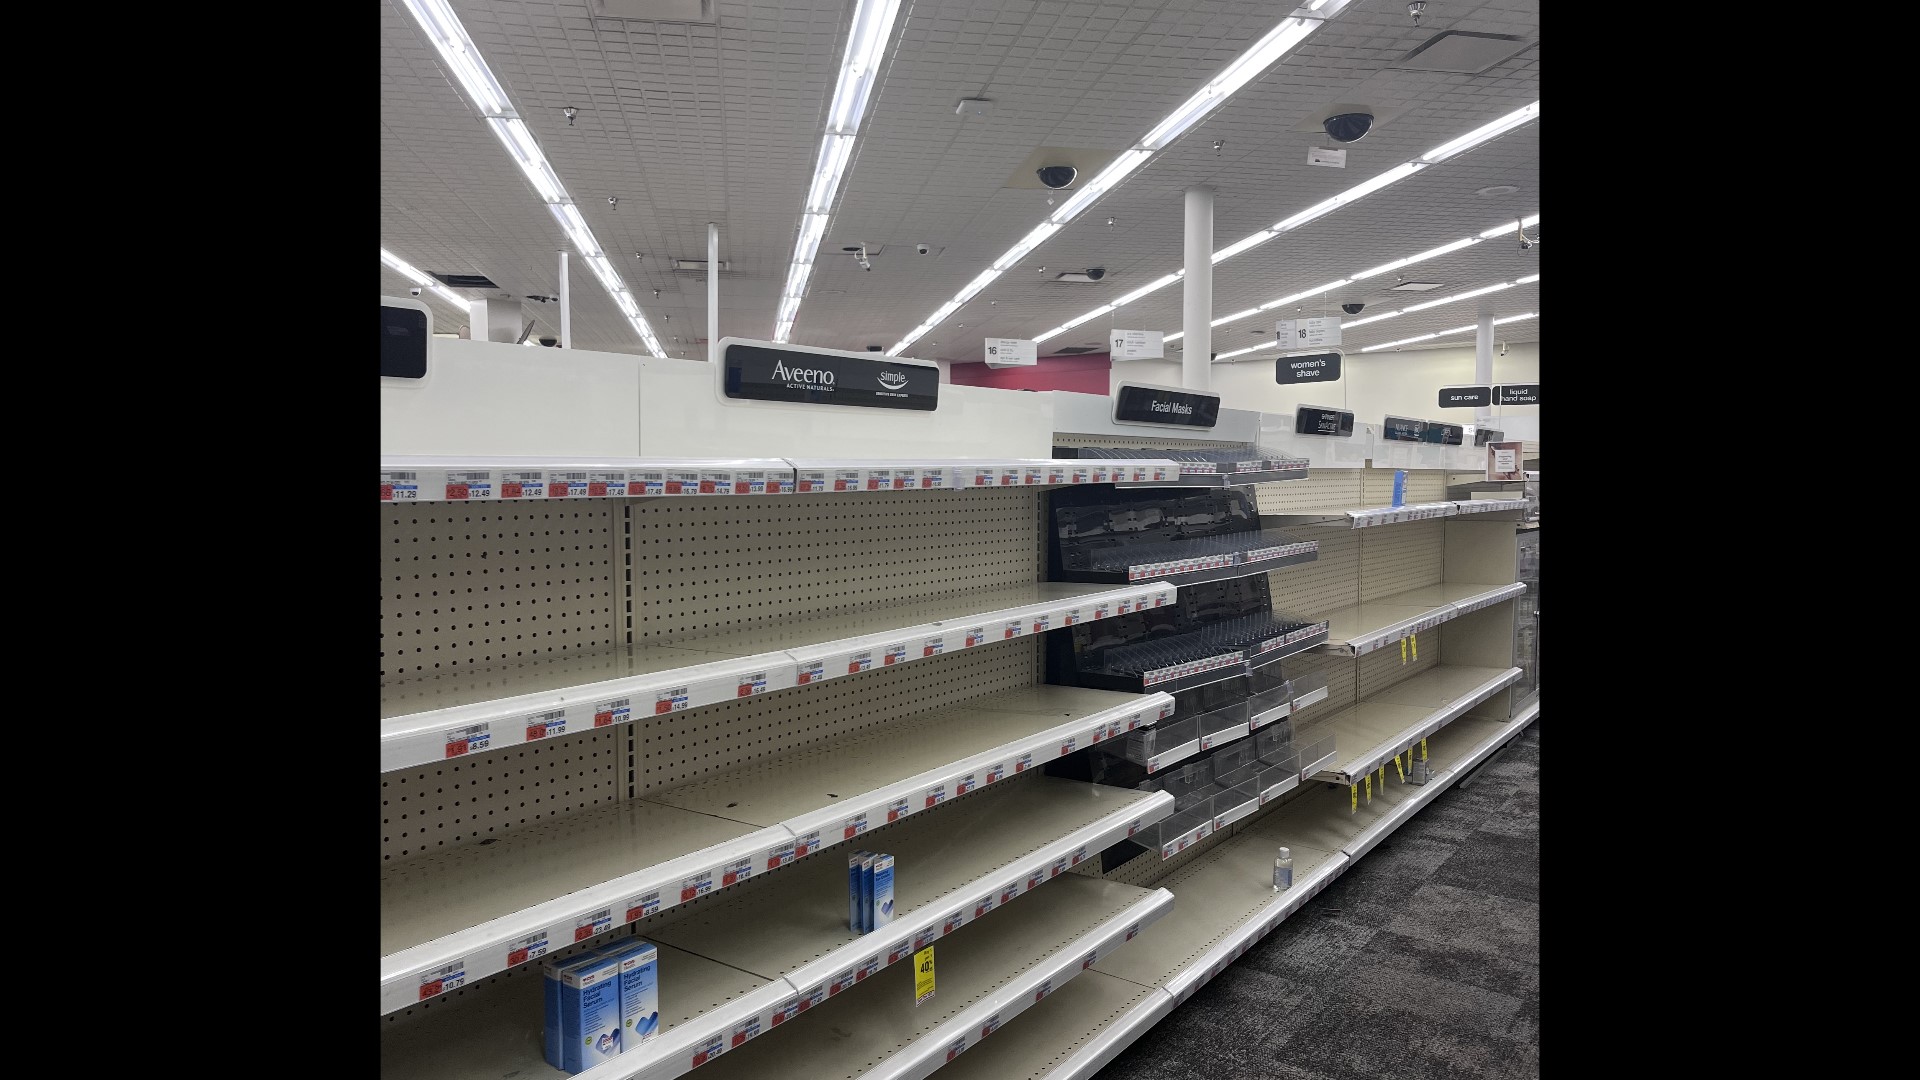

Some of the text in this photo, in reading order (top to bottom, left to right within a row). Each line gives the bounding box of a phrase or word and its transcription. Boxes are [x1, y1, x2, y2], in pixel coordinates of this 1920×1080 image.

[1115, 339, 1124, 348] 17
[987, 346, 997, 355] 16
[1290, 359, 1326, 369] women's
[771, 359, 836, 385] Aveeno
[880, 371, 906, 384] simple
[1296, 370, 1320, 378] shave
[1151, 400, 1193, 415] Facial Masks
[548, 726, 566, 736] 11.99
[531, 947, 547, 957] 7.59
[623, 965, 651, 980] Hydrating
[445, 979, 465, 991] 10.79
[623, 977, 641, 987] Facial
[623, 982, 643, 993] Serum
[582, 980, 612, 997] Hydrating
[582, 992, 601, 1003] Facial
[582, 997, 603, 1009] Serum
